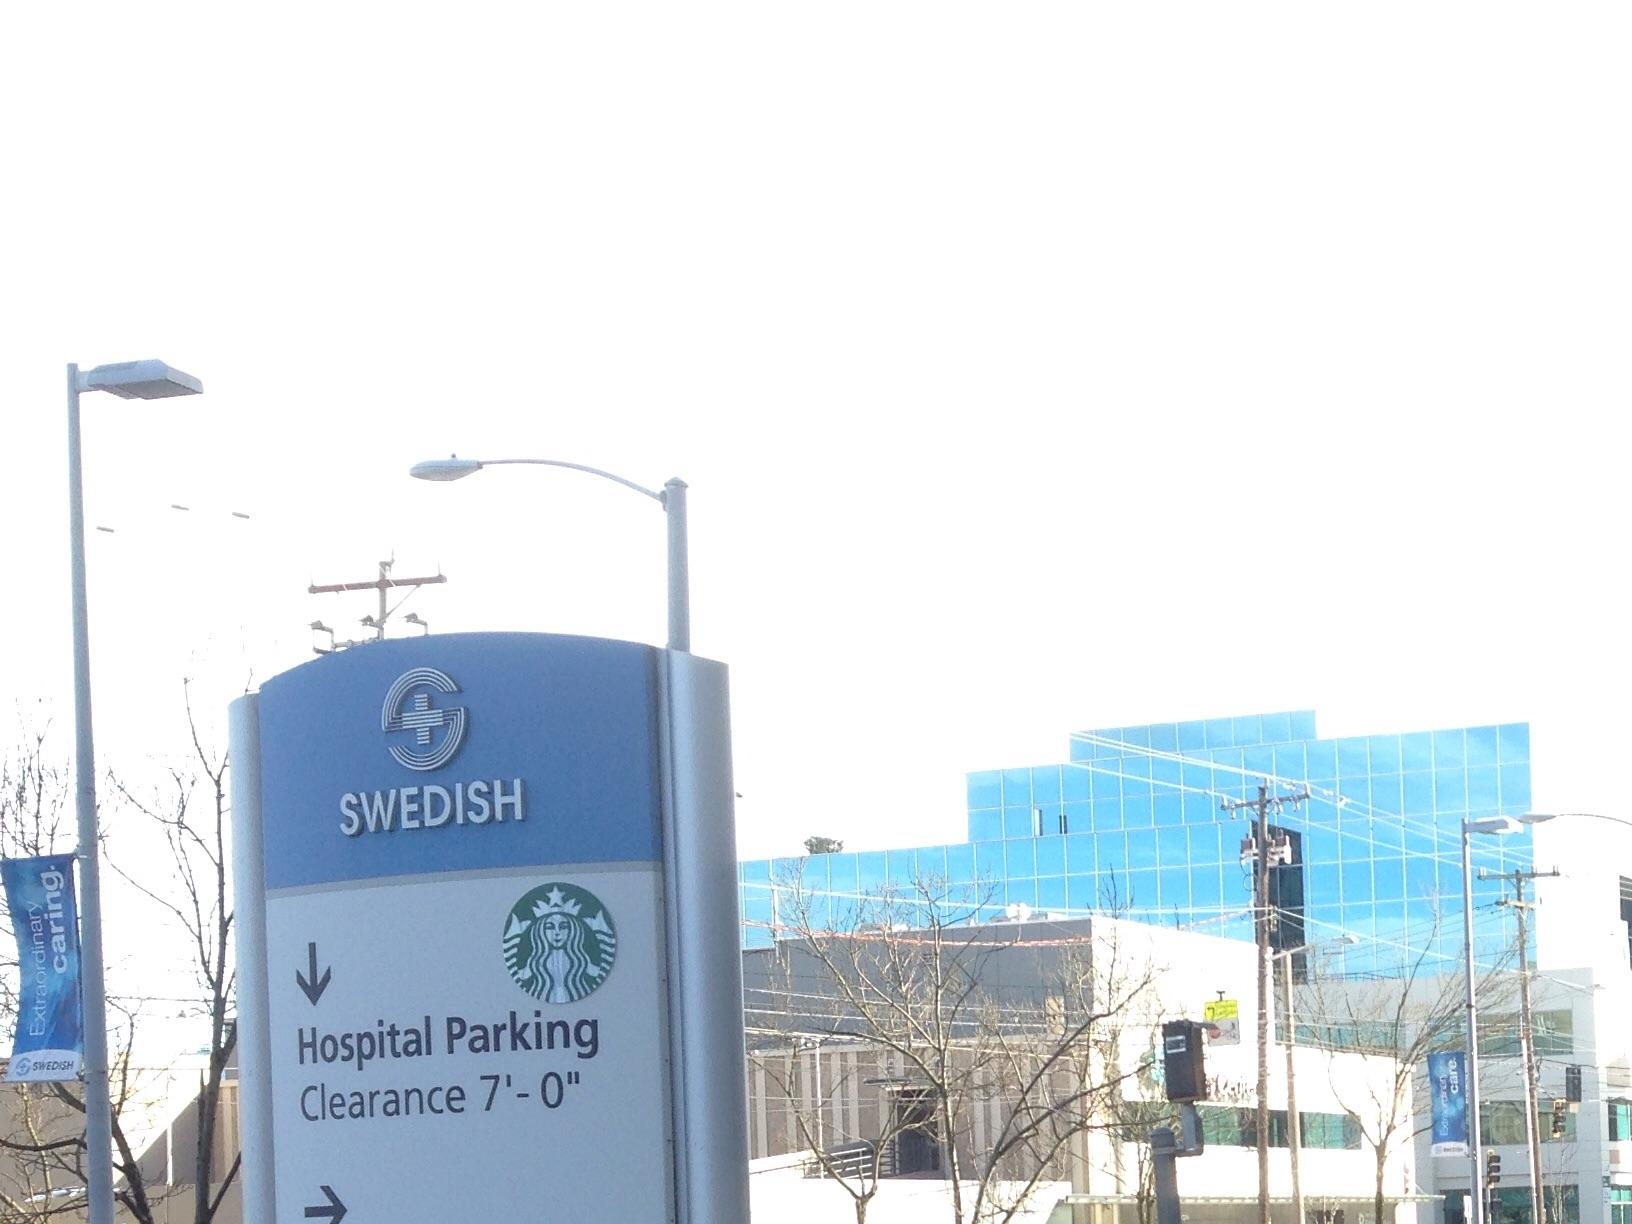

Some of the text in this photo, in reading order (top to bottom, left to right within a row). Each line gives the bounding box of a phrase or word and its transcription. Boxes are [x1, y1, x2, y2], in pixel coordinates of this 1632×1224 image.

[339, 777, 525, 837] SWEDISH
[28, 900, 46, 1036] Extraordinary
[32, 1060, 74, 1071] SWEDISH
[297, 1010, 599, 1071] Hospital Parking
[300, 1083, 466, 1122] Clearance
